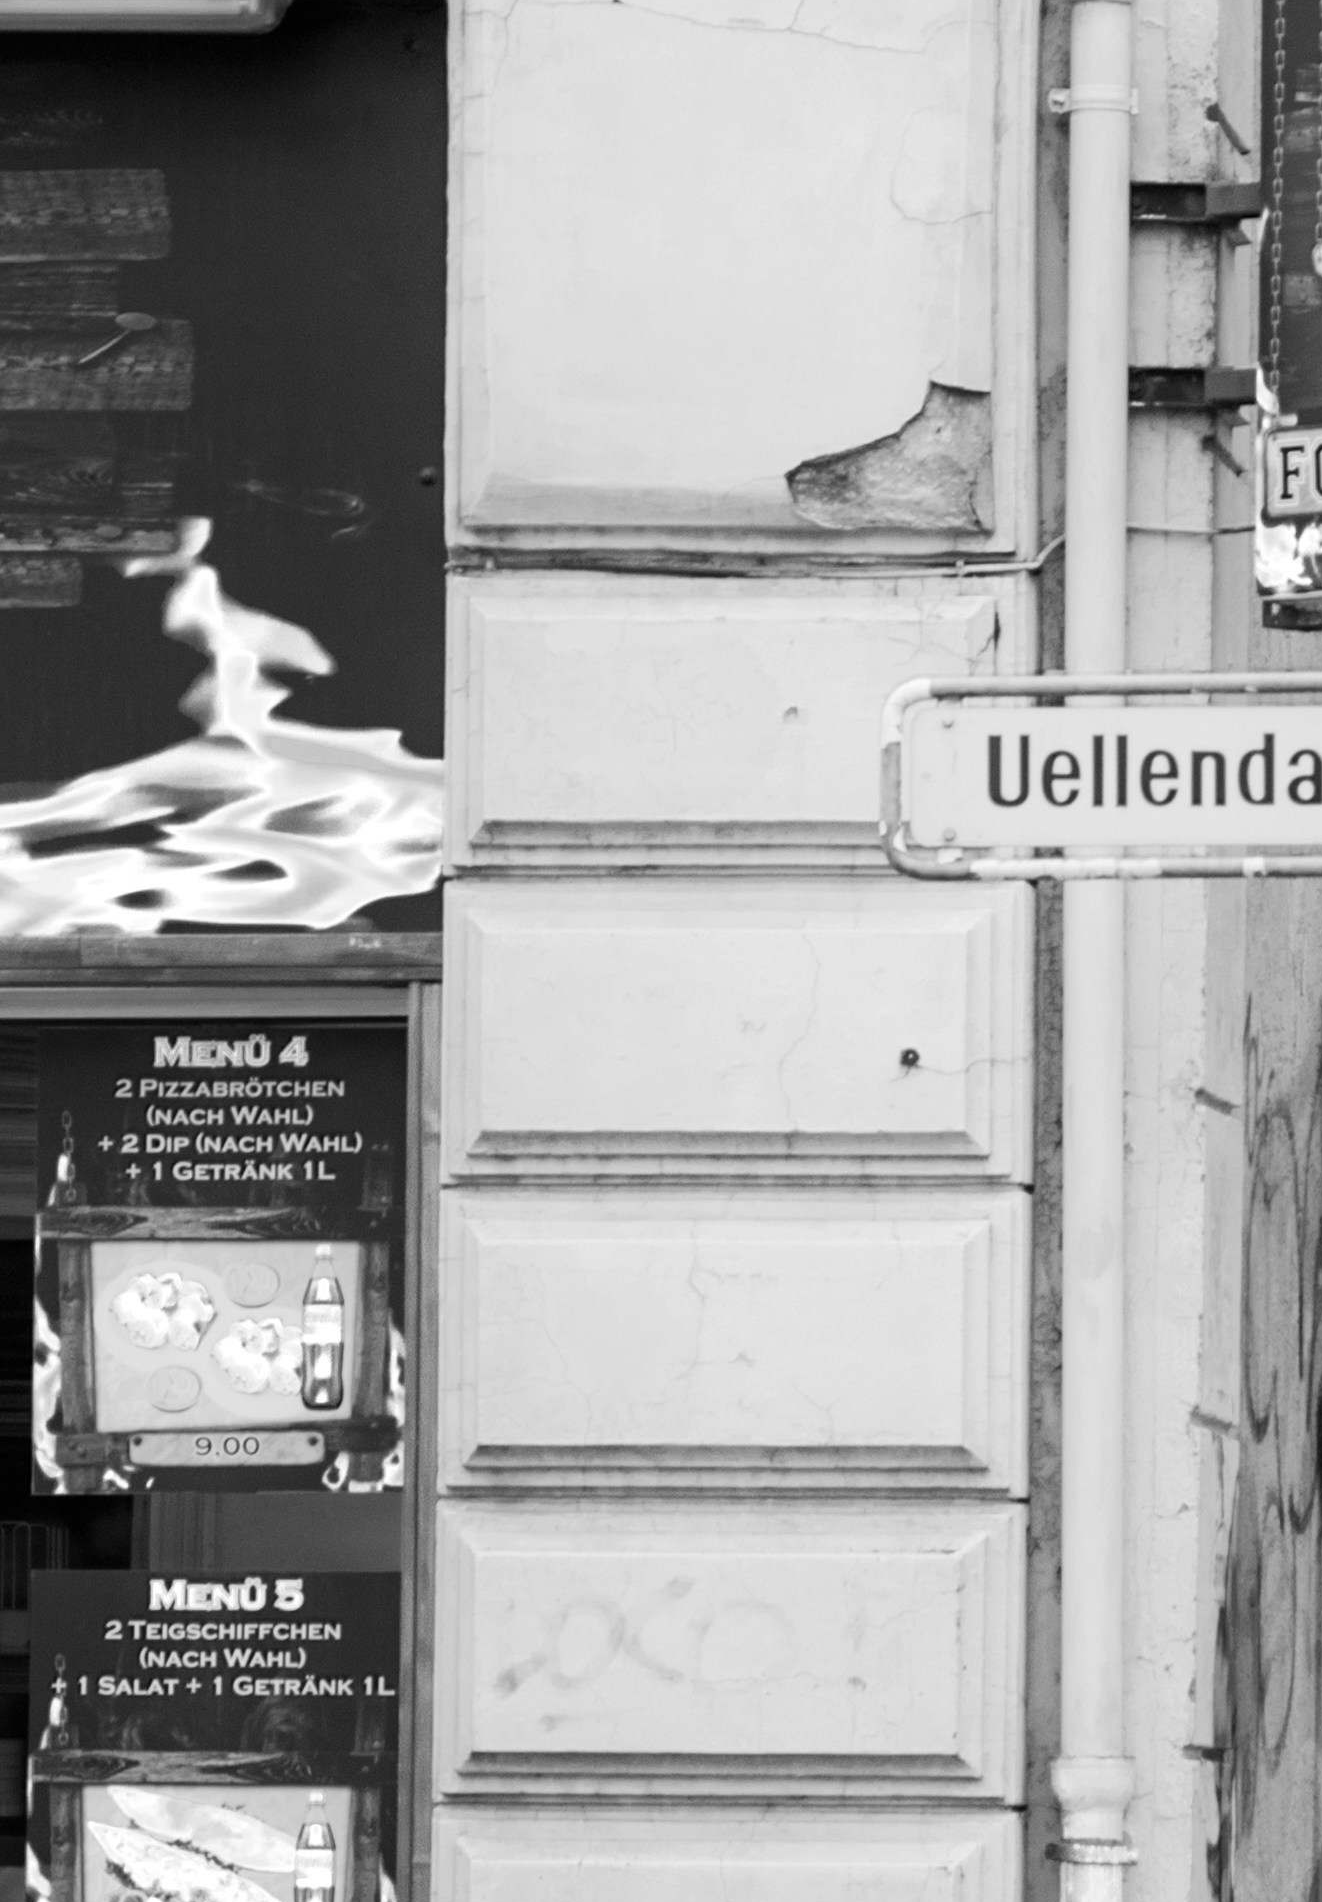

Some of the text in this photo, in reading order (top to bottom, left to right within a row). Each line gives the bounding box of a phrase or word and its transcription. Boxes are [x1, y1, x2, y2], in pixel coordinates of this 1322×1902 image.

[279, 1034, 309, 1067] 4
[115, 1076, 133, 1098] 2
[98, 1133, 114, 1155] +
[120, 1133, 139, 1155] 2
[126, 1160, 141, 1181] +
[151, 1160, 163, 1181] 1
[301, 1160, 336, 1181] 1L
[195, 1436, 260, 1458] 9.00
[274, 1577, 304, 1611] 5
[104, 1620, 122, 1641] 2
[51, 1675, 67, 1697] +
[77, 1675, 90, 1697] 1
[186, 1675, 201, 1697] +
[211, 1675, 224, 1697] 1
[363, 1675, 394, 1697] 1L
